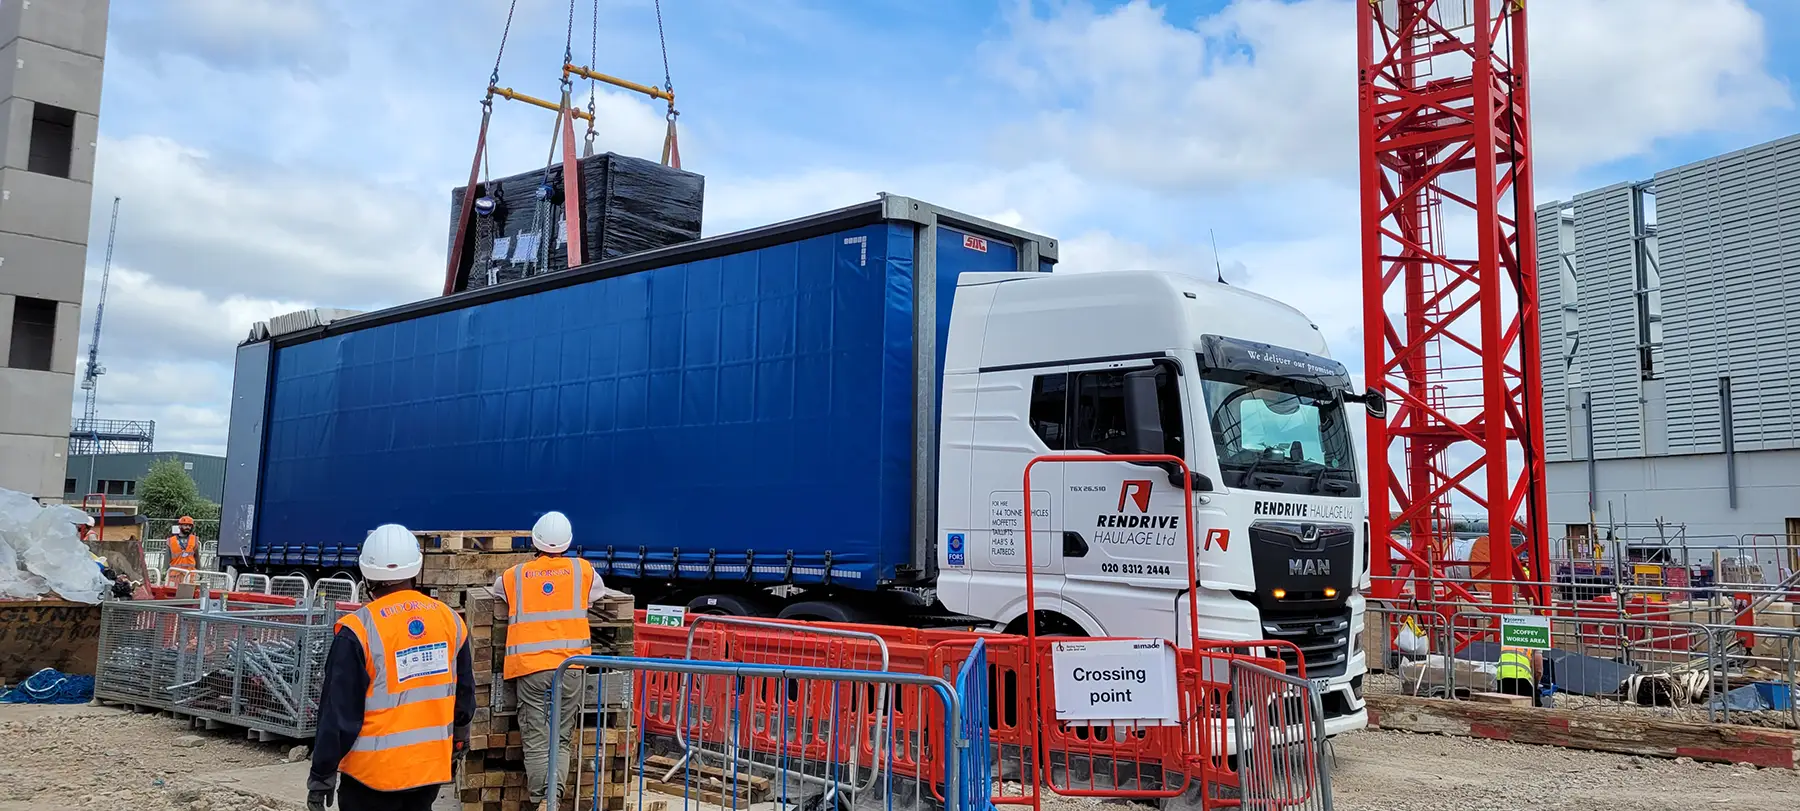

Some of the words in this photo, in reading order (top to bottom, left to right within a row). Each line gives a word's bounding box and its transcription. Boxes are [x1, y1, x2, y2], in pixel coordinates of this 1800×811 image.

[1248, 350, 1260, 360] We
[1263, 353, 1291, 365] deliver
[1307, 363, 1335, 376] promises
[1254, 501, 1308, 516] RENDRIVE
[1310, 505, 1342, 518] HAULAGE
[1344, 506, 1353, 519] Ltd
[992, 518, 1017, 526] MOFFETTS
[1096, 515, 1179, 528] RENDRIVE
[1093, 531, 1153, 545] HAULAGE
[1156, 532, 1176, 546] Ltd
[992, 547, 1015, 556] FLATBEDS
[1101, 563, 1119, 573] 020
[1122, 564, 1143, 574] 8312
[1146, 565, 1170, 575] 2444
[1288, 559, 1331, 576] MAN
[1073, 666, 1146, 683] Crossing
[1090, 689, 1132, 706] point
